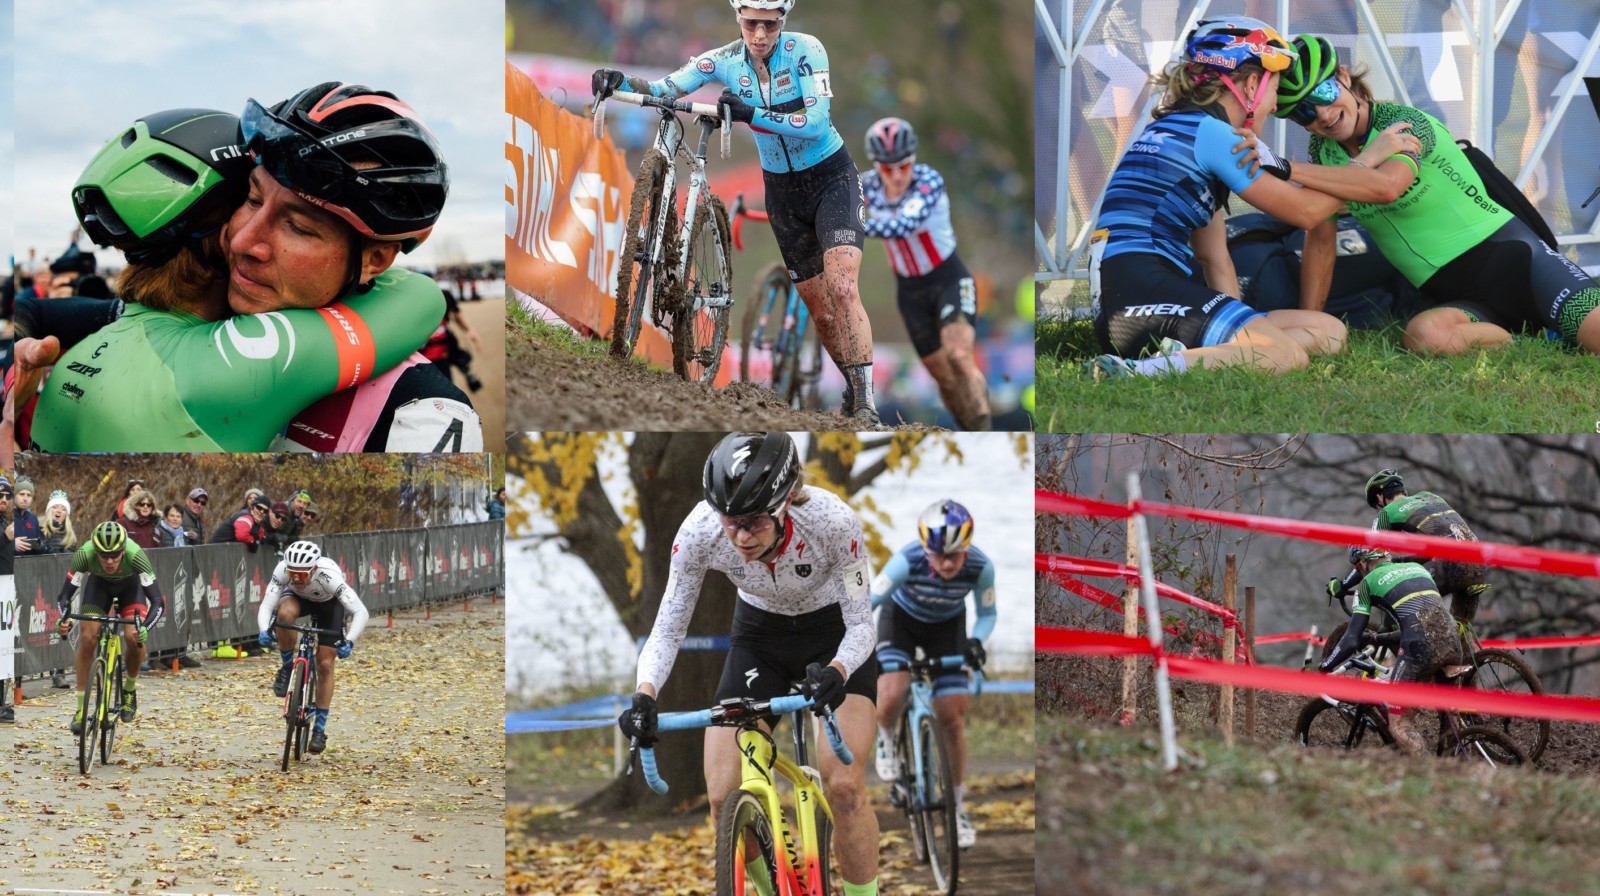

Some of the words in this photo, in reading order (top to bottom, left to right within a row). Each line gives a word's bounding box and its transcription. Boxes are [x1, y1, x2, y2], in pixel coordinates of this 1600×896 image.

[1196, 53, 1215, 65] Red
[1216, 56, 1236, 69] Bull
[822, 79, 828, 91] 1
[739, 89, 753, 98] AG
[761, 112, 784, 124] AG
[1431, 154, 1500, 214] WaowDeals
[1124, 303, 1193, 317] TREK
[1550, 288, 1571, 319] GIRO
[66, 361, 102, 378] ZIPP
[292, 421, 335, 440] ZIPP
[855, 571, 864, 586] 3
[29, 605, 46, 634] Race
[800, 790, 808, 802] 3
